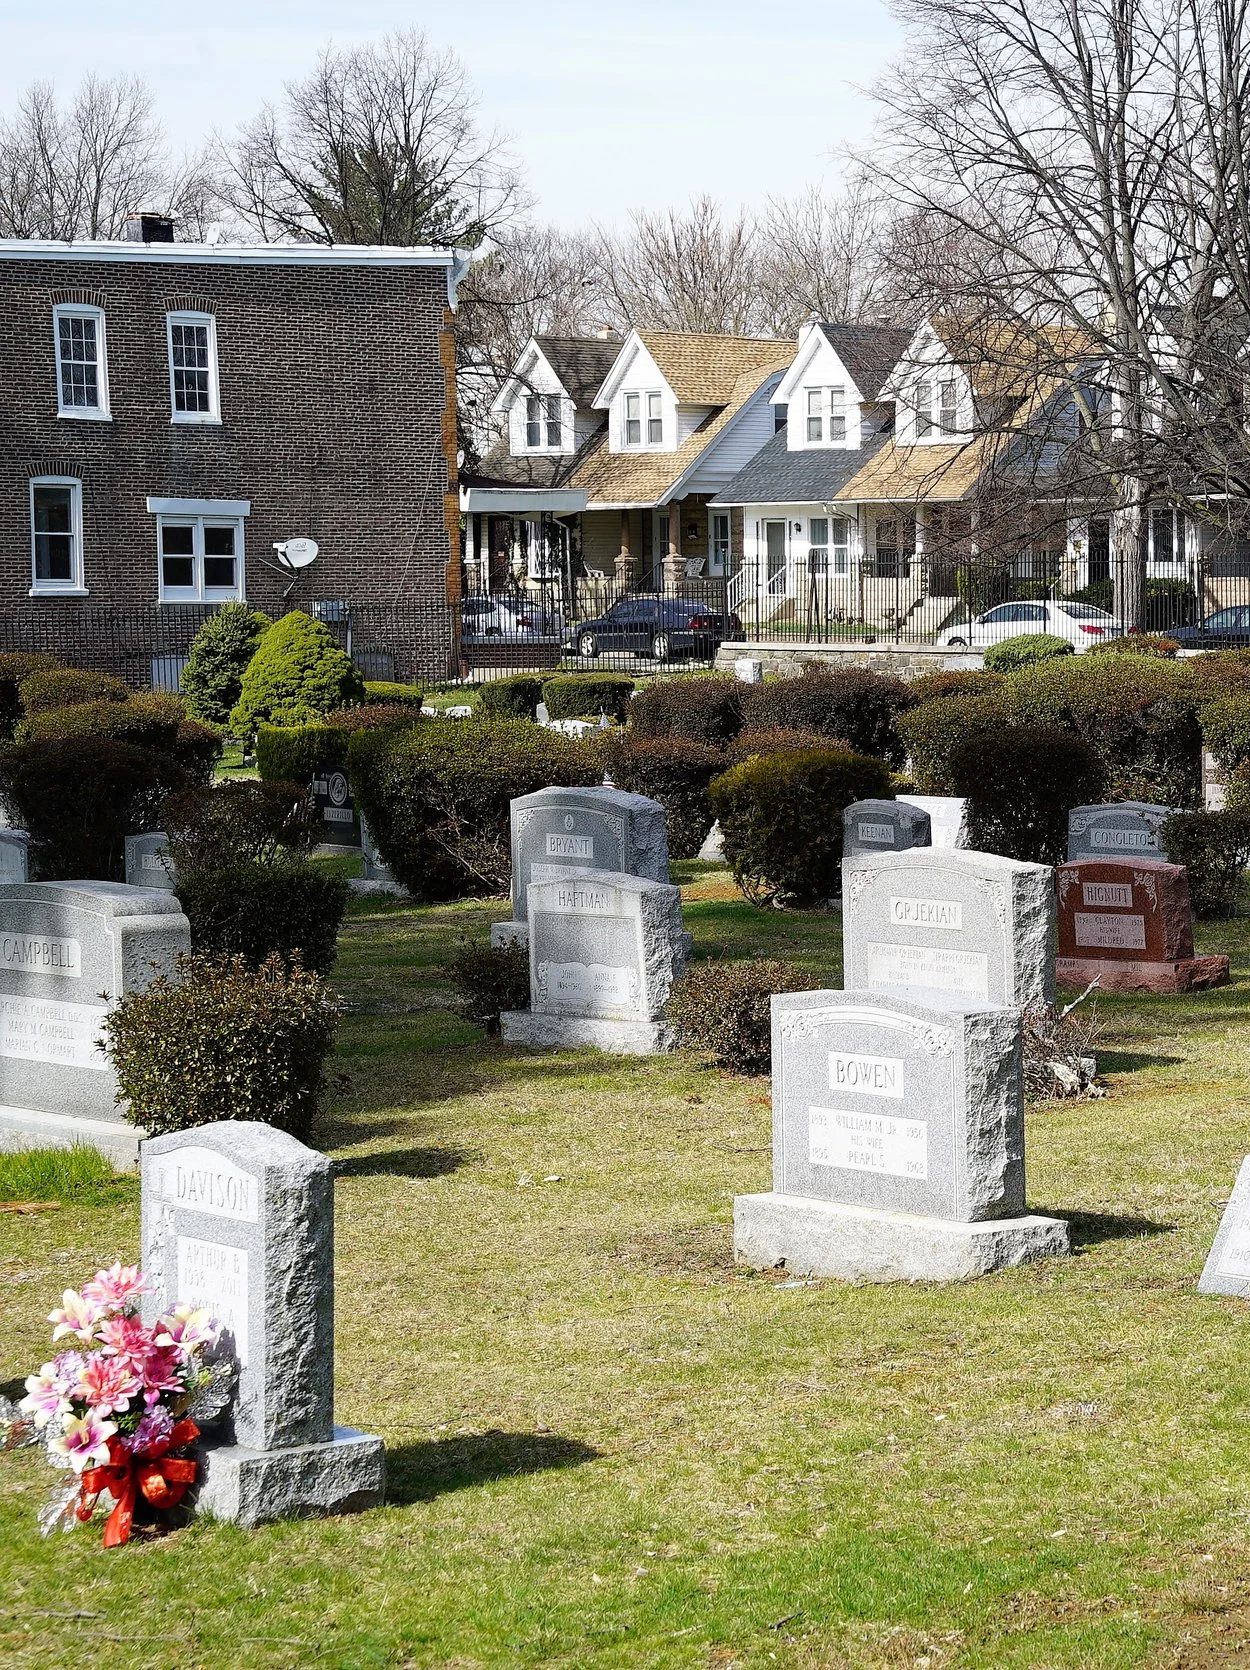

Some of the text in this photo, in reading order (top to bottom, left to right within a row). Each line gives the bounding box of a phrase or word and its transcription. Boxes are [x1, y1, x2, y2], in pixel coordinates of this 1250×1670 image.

[861, 826, 891, 839] KEENAN
[549, 837, 590, 855] BRYANT
[1086, 886, 1128, 904] HIGNUTT
[1095, 916, 1123, 926] CLAYTON
[3, 938, 74, 968] CAMPBELL
[40, 1024, 76, 1041] CAMPBELL
[835, 1059, 896, 1090] BOWEN
[835, 1115, 872, 1132] WILLIAM
[848, 1150, 877, 1167] PEARL
[176, 1165, 251, 1212] DAVISON
